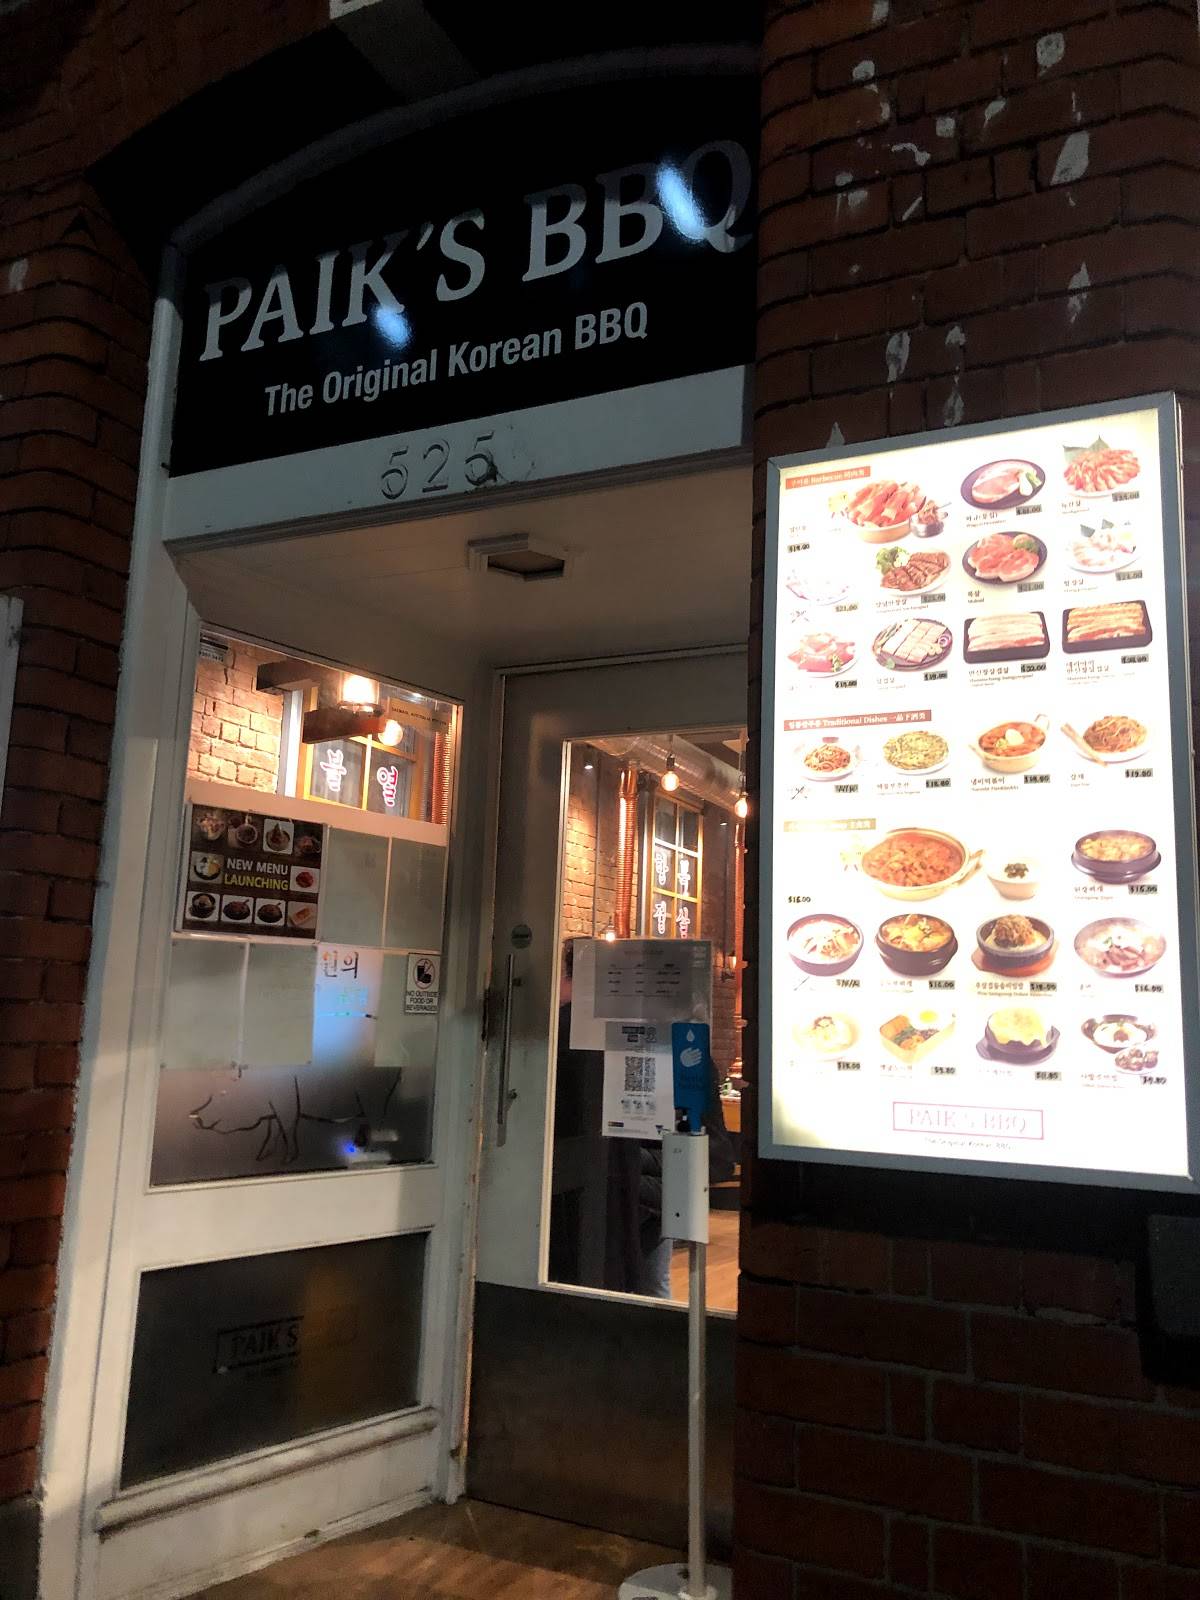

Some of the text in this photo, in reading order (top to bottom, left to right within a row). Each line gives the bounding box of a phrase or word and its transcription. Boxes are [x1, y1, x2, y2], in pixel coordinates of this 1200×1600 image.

[199, 138, 754, 363] PAIK'S BBQ
[264, 301, 650, 417] The Original Korean BBQ
[381, 431, 496, 500] 525
[822, 715, 863, 728] Traditional
[863, 713, 889, 724] Dishes
[224, 873, 288, 891] LAUNCHING
[227, 857, 288, 876] NEW MENU
